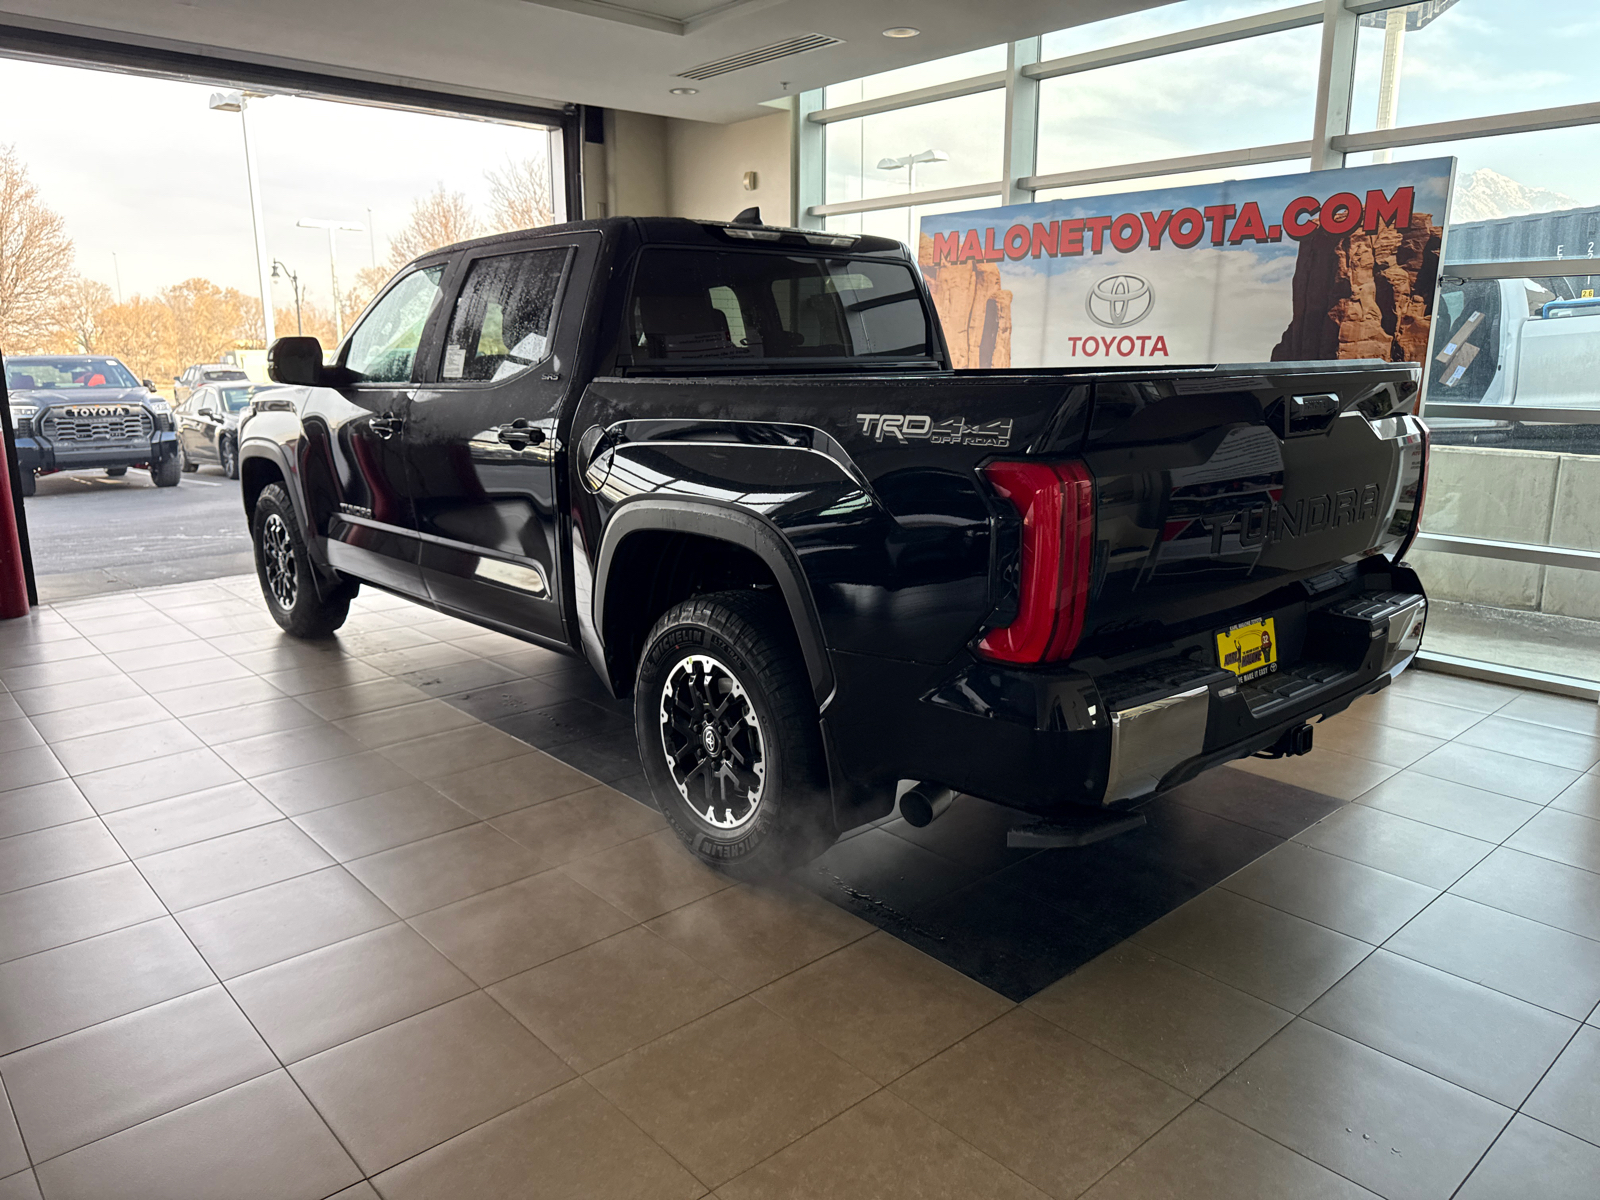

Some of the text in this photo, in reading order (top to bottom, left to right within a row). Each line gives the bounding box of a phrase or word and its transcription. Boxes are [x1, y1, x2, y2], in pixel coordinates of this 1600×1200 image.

[933, 186, 1416, 265] MALONETOYOTA.COM
[1068, 335, 1169, 357] TOYOTA
[71, 407, 125, 417] TOYOTA
[856, 413, 934, 444] TRD
[930, 435, 1010, 447] OFF ROAD
[1200, 482, 1380, 559] TUNDRA
[651, 629, 703, 662] MICHELIN
[714, 637, 743, 666] LTX TRAIL
[1262, 634, 1269, 644] 32
[702, 830, 760, 858] MICHELIN
